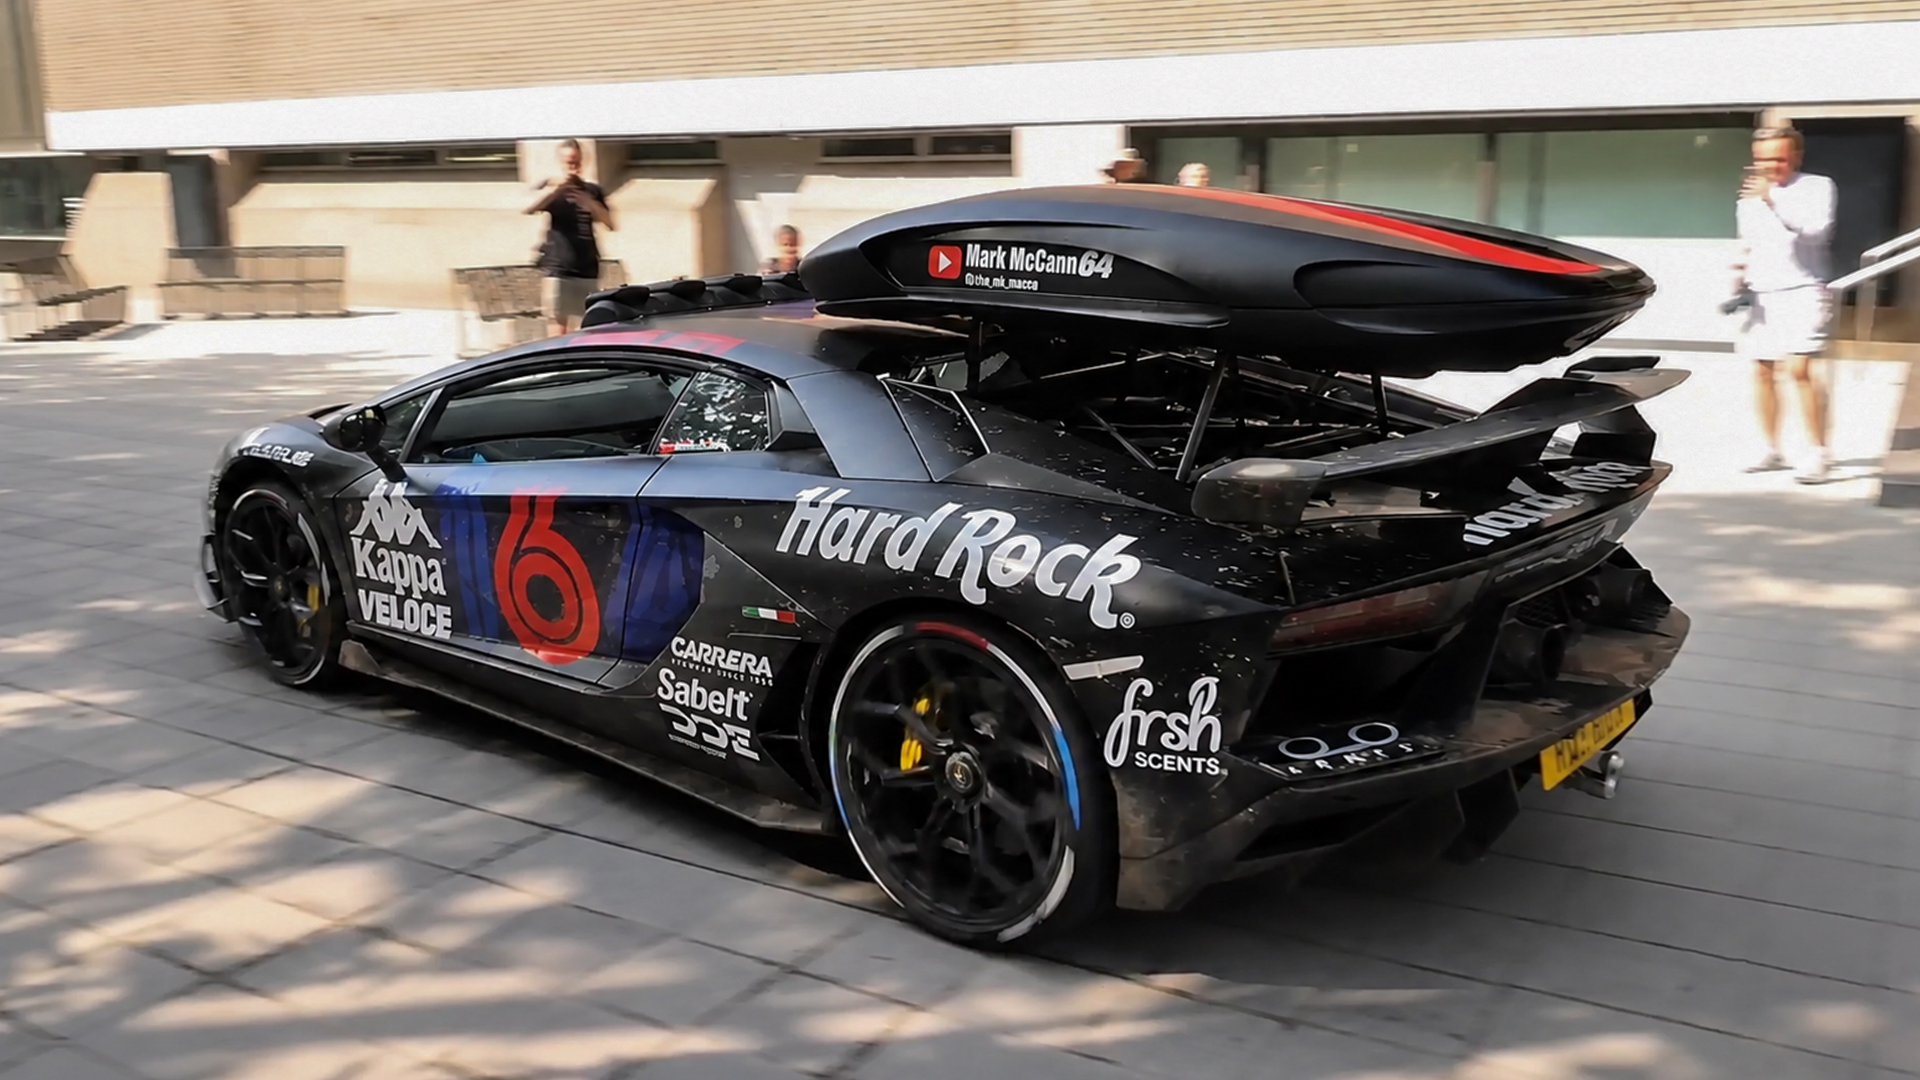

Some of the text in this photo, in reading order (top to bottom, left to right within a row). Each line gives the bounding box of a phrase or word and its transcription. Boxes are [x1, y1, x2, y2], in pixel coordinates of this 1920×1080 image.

[966, 243, 1006, 270] Mark
[775, 486, 964, 572] Hard
[351, 536, 447, 600] Kappa
[358, 588, 452, 640] VELOCE
[670, 636, 774, 679] CARRERA
[657, 668, 754, 722] Sabelt
[1104, 677, 1223, 768] frsh
[1134, 750, 1221, 776] SCENTS
